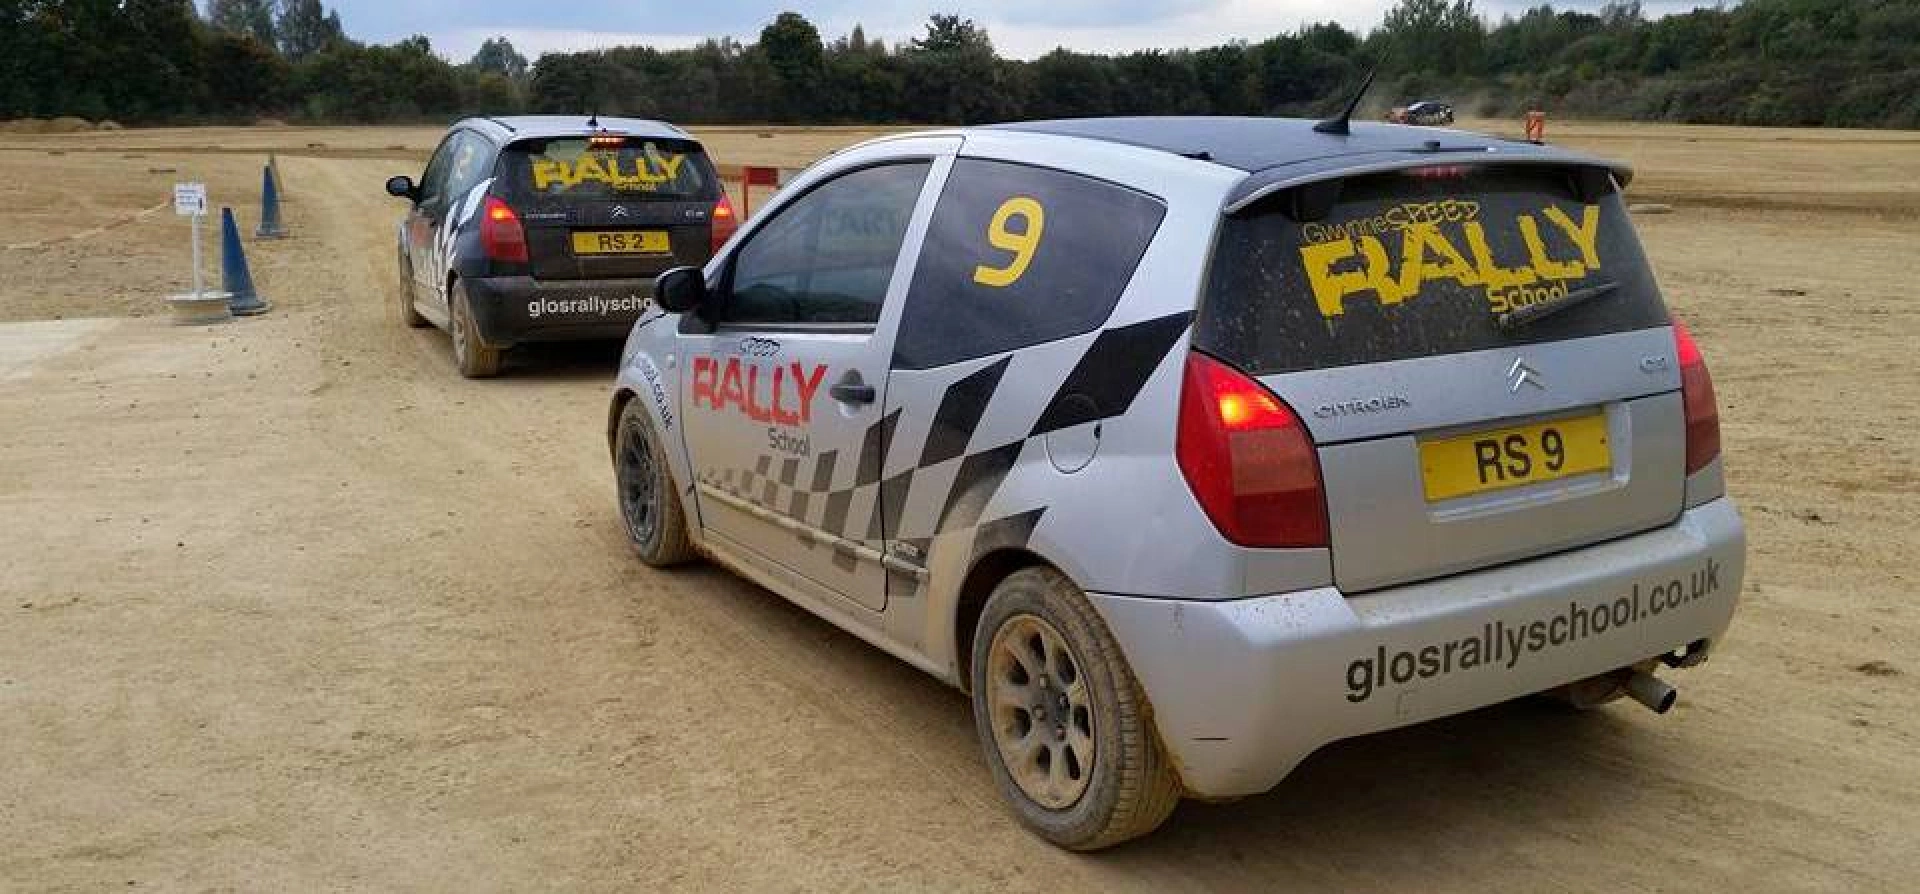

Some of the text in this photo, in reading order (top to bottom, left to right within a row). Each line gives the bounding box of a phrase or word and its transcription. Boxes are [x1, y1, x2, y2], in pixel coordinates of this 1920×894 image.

[532, 153, 685, 190] RALLY
[597, 233, 645, 250] RS 2
[973, 196, 1044, 287] 9
[1299, 204, 1601, 317] RALLY
[1486, 281, 1570, 313] School
[692, 356, 828, 426] RALLY
[767, 427, 811, 458] School
[1474, 427, 1566, 484] RS 9
[1346, 557, 1720, 703] glosrallyschool.co.uk
